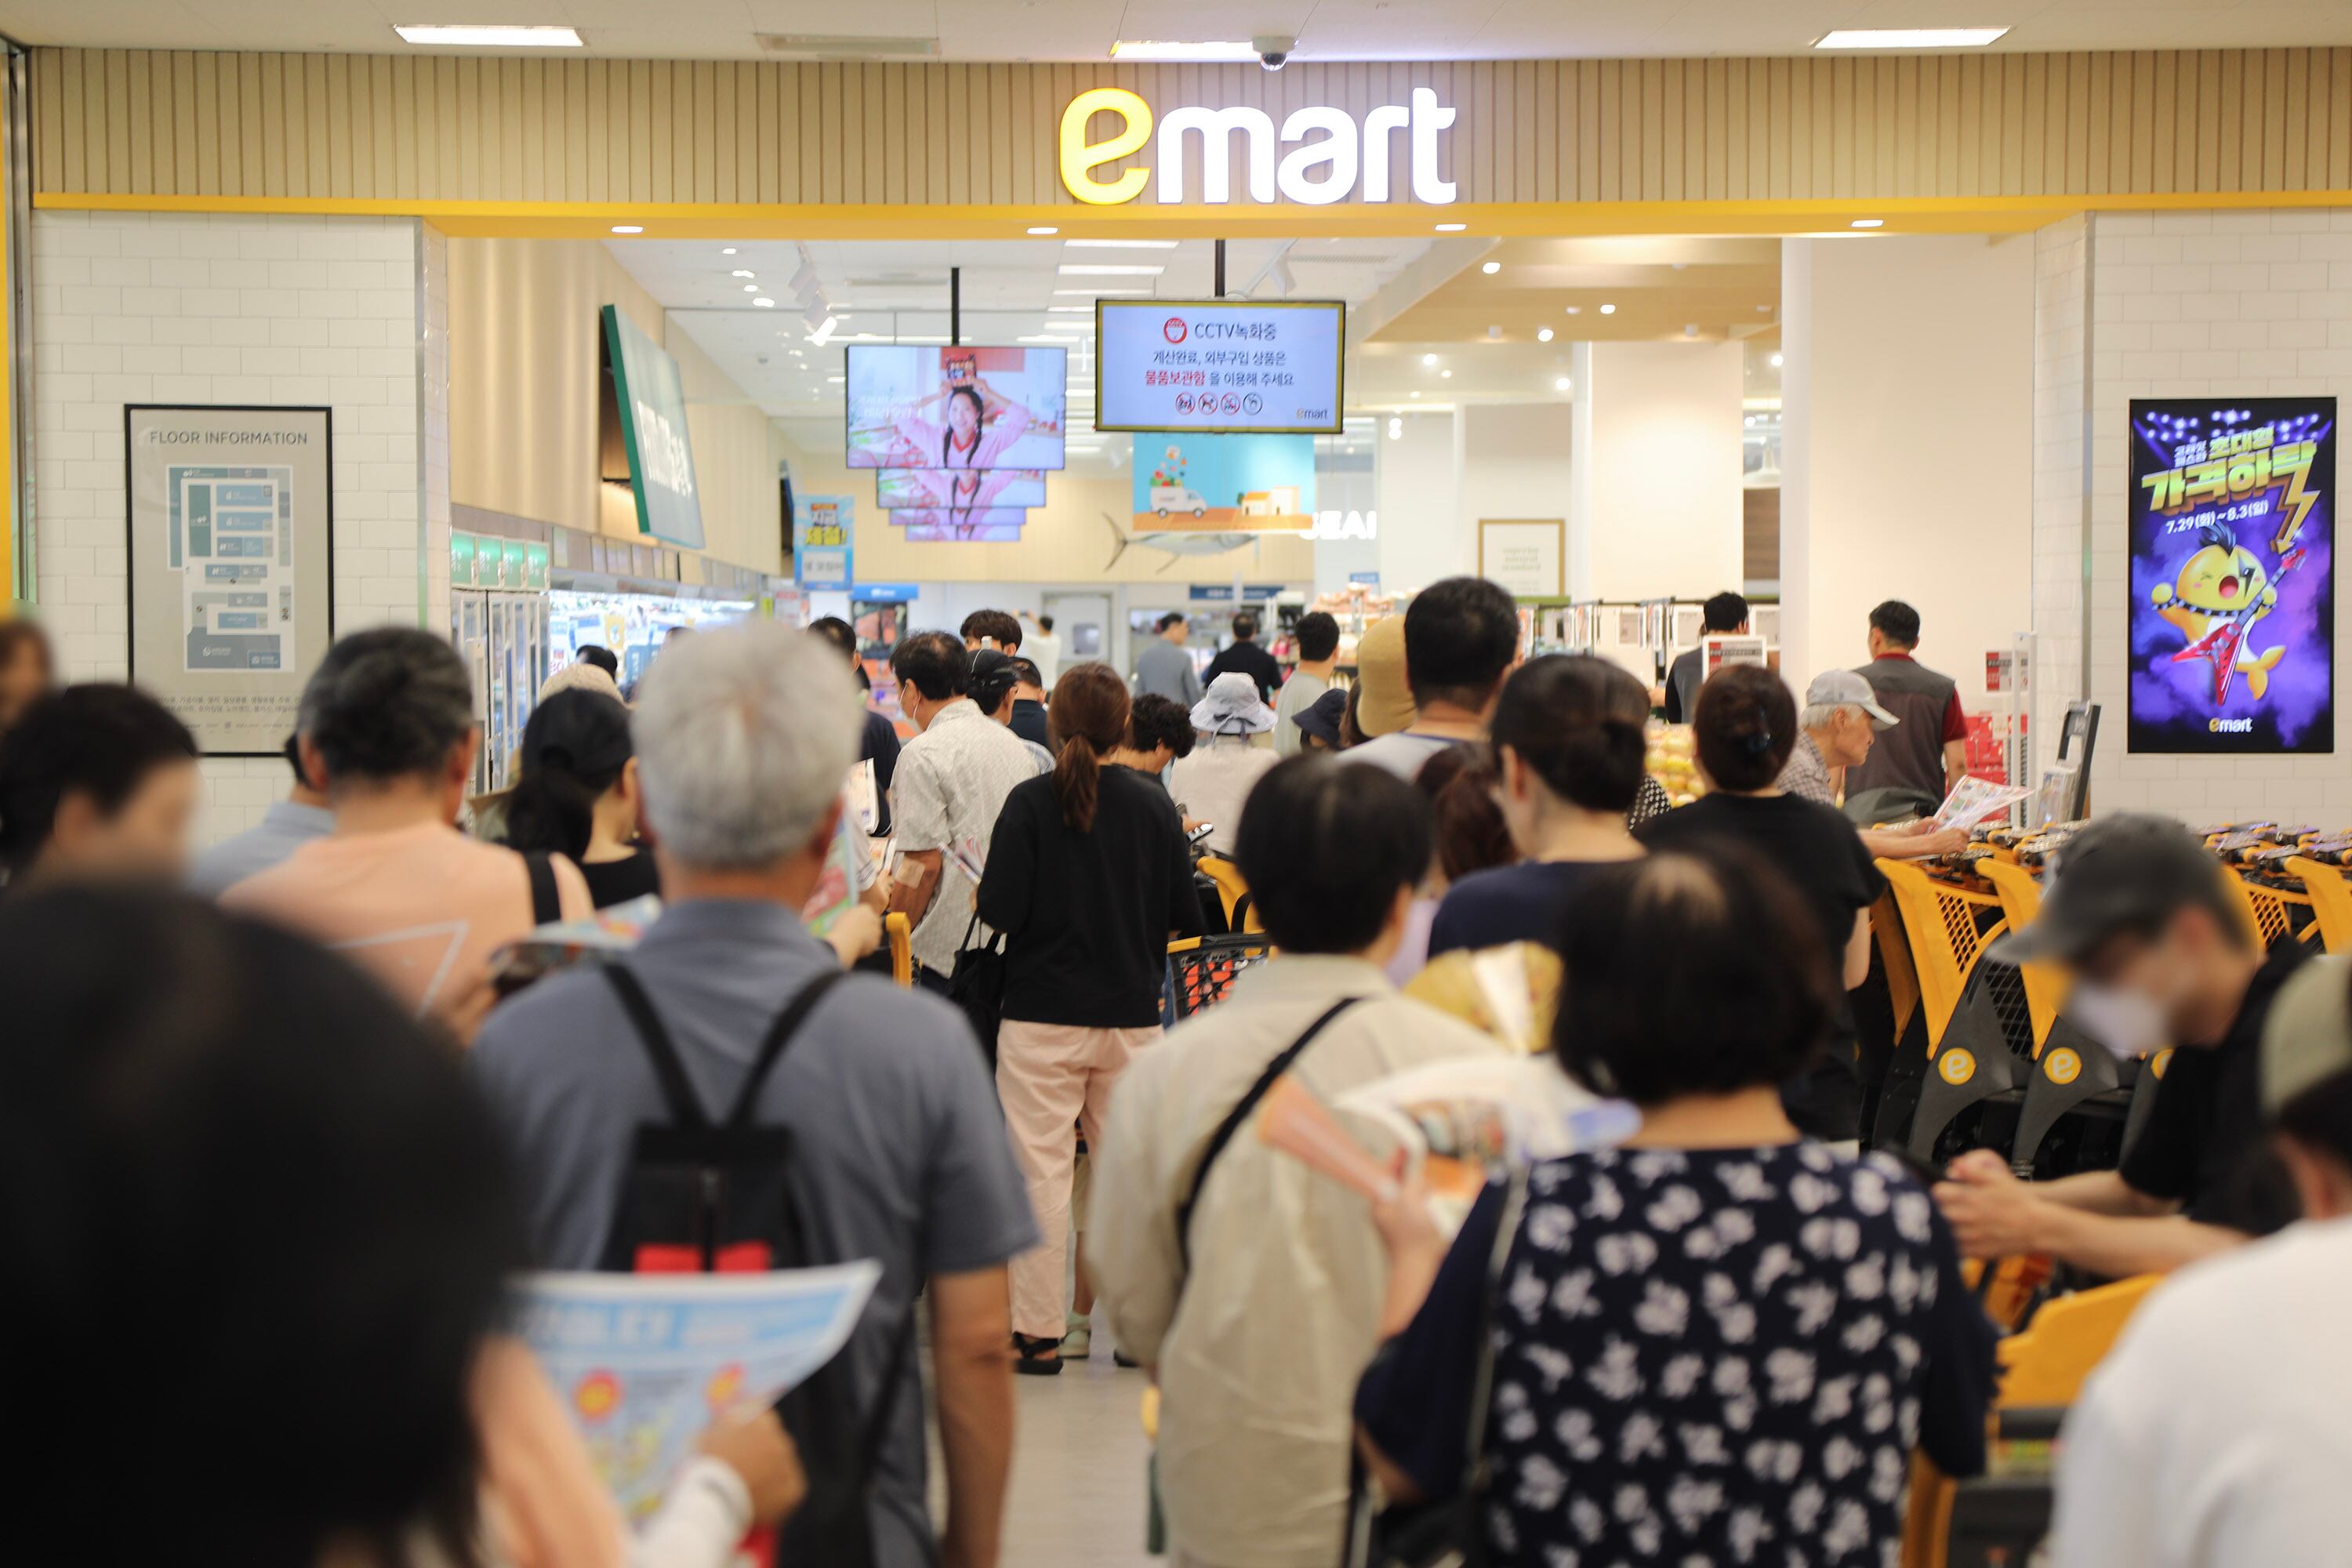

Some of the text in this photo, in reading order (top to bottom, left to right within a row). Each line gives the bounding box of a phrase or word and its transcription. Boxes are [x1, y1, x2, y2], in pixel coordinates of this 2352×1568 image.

[1059, 87, 1457, 205] emart
[1195, 321, 1277, 341] CCTV녹화중
[1261, 371, 1294, 387] 주세요
[150, 431, 307, 445] FLOOR INFORMATION
[2209, 717, 2252, 732] emart
